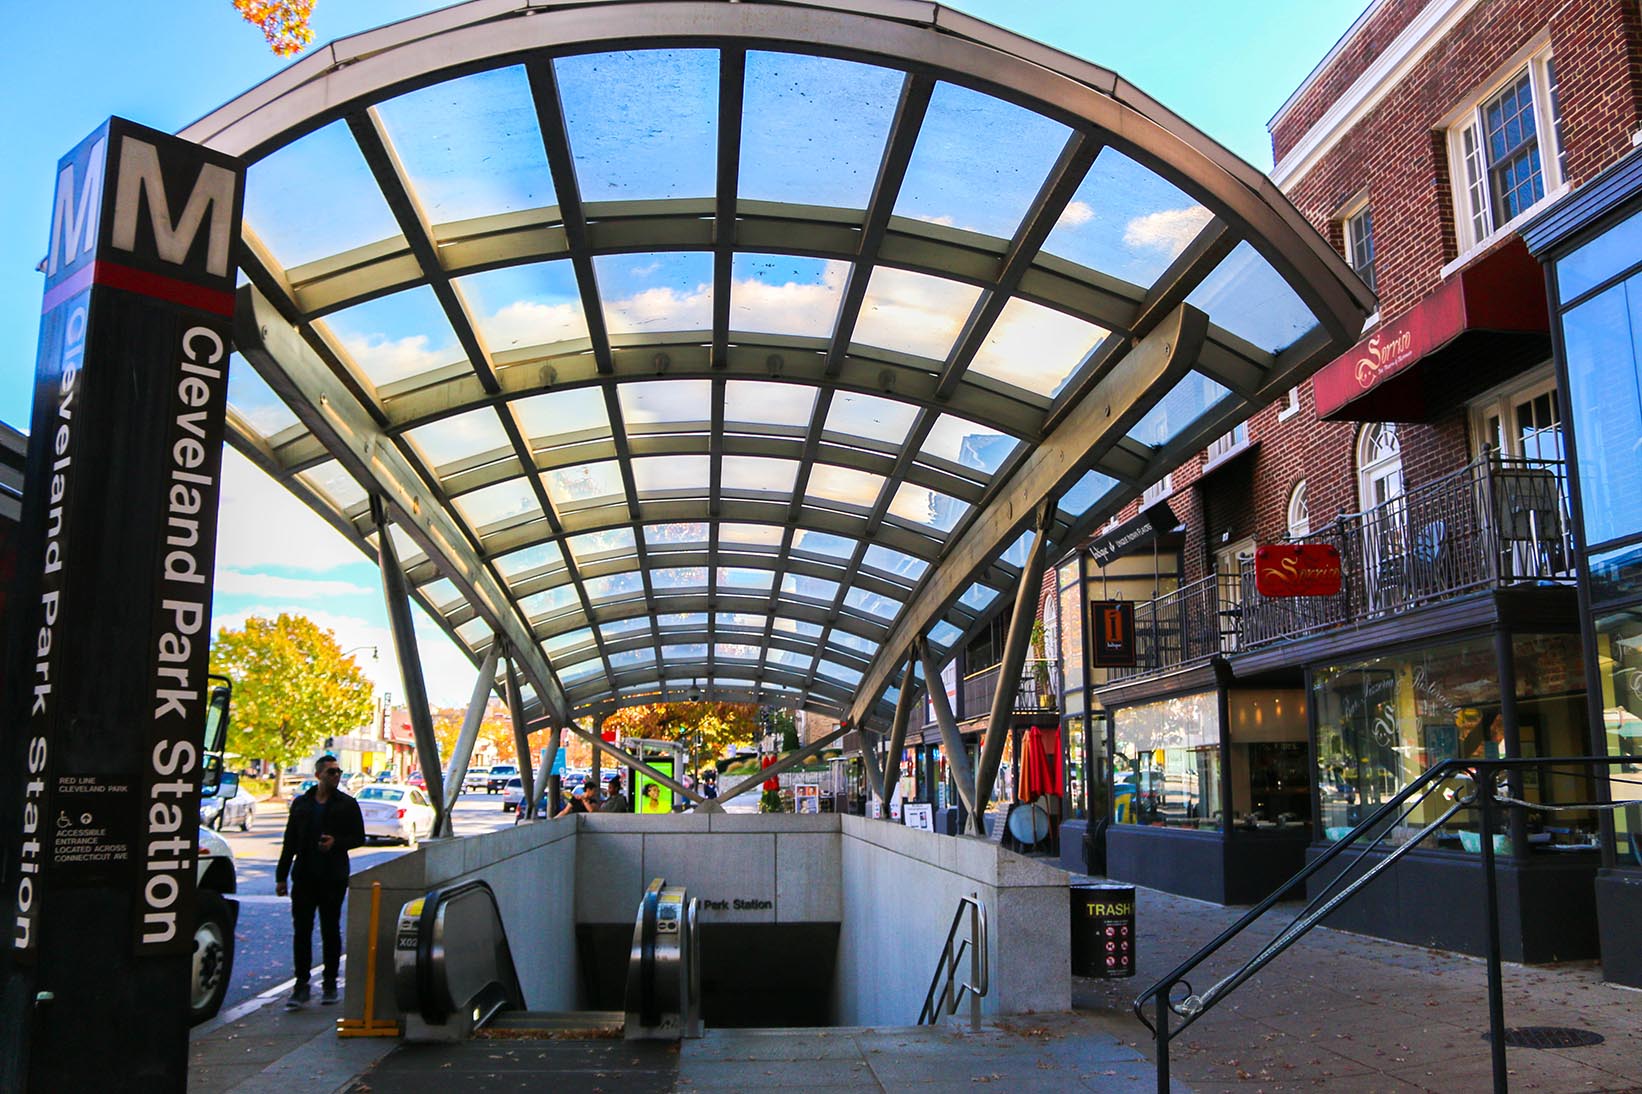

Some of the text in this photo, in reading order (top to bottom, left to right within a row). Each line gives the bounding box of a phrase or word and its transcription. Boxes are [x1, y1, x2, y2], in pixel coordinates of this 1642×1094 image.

[48, 137, 105, 278] M
[111, 135, 236, 278] M
[1355, 331, 1411, 386] Sorriso
[14, 306, 87, 949] Cleveland Park Station
[142, 327, 223, 944] Cleveland Park Station
[78, 777, 96, 785] LINE
[58, 785, 106, 793] CLEVELAND
[56, 829, 106, 837] ACCESSIBLE
[55, 837, 98, 846] ENTRANCE
[55, 844, 127, 854] LOCATED ACROSS
[54, 852, 128, 863] CONNECTICUT AVE
[704, 899, 729, 910] Park
[733, 898, 773, 910] Station
[1087, 903, 1131, 917] TRASH
